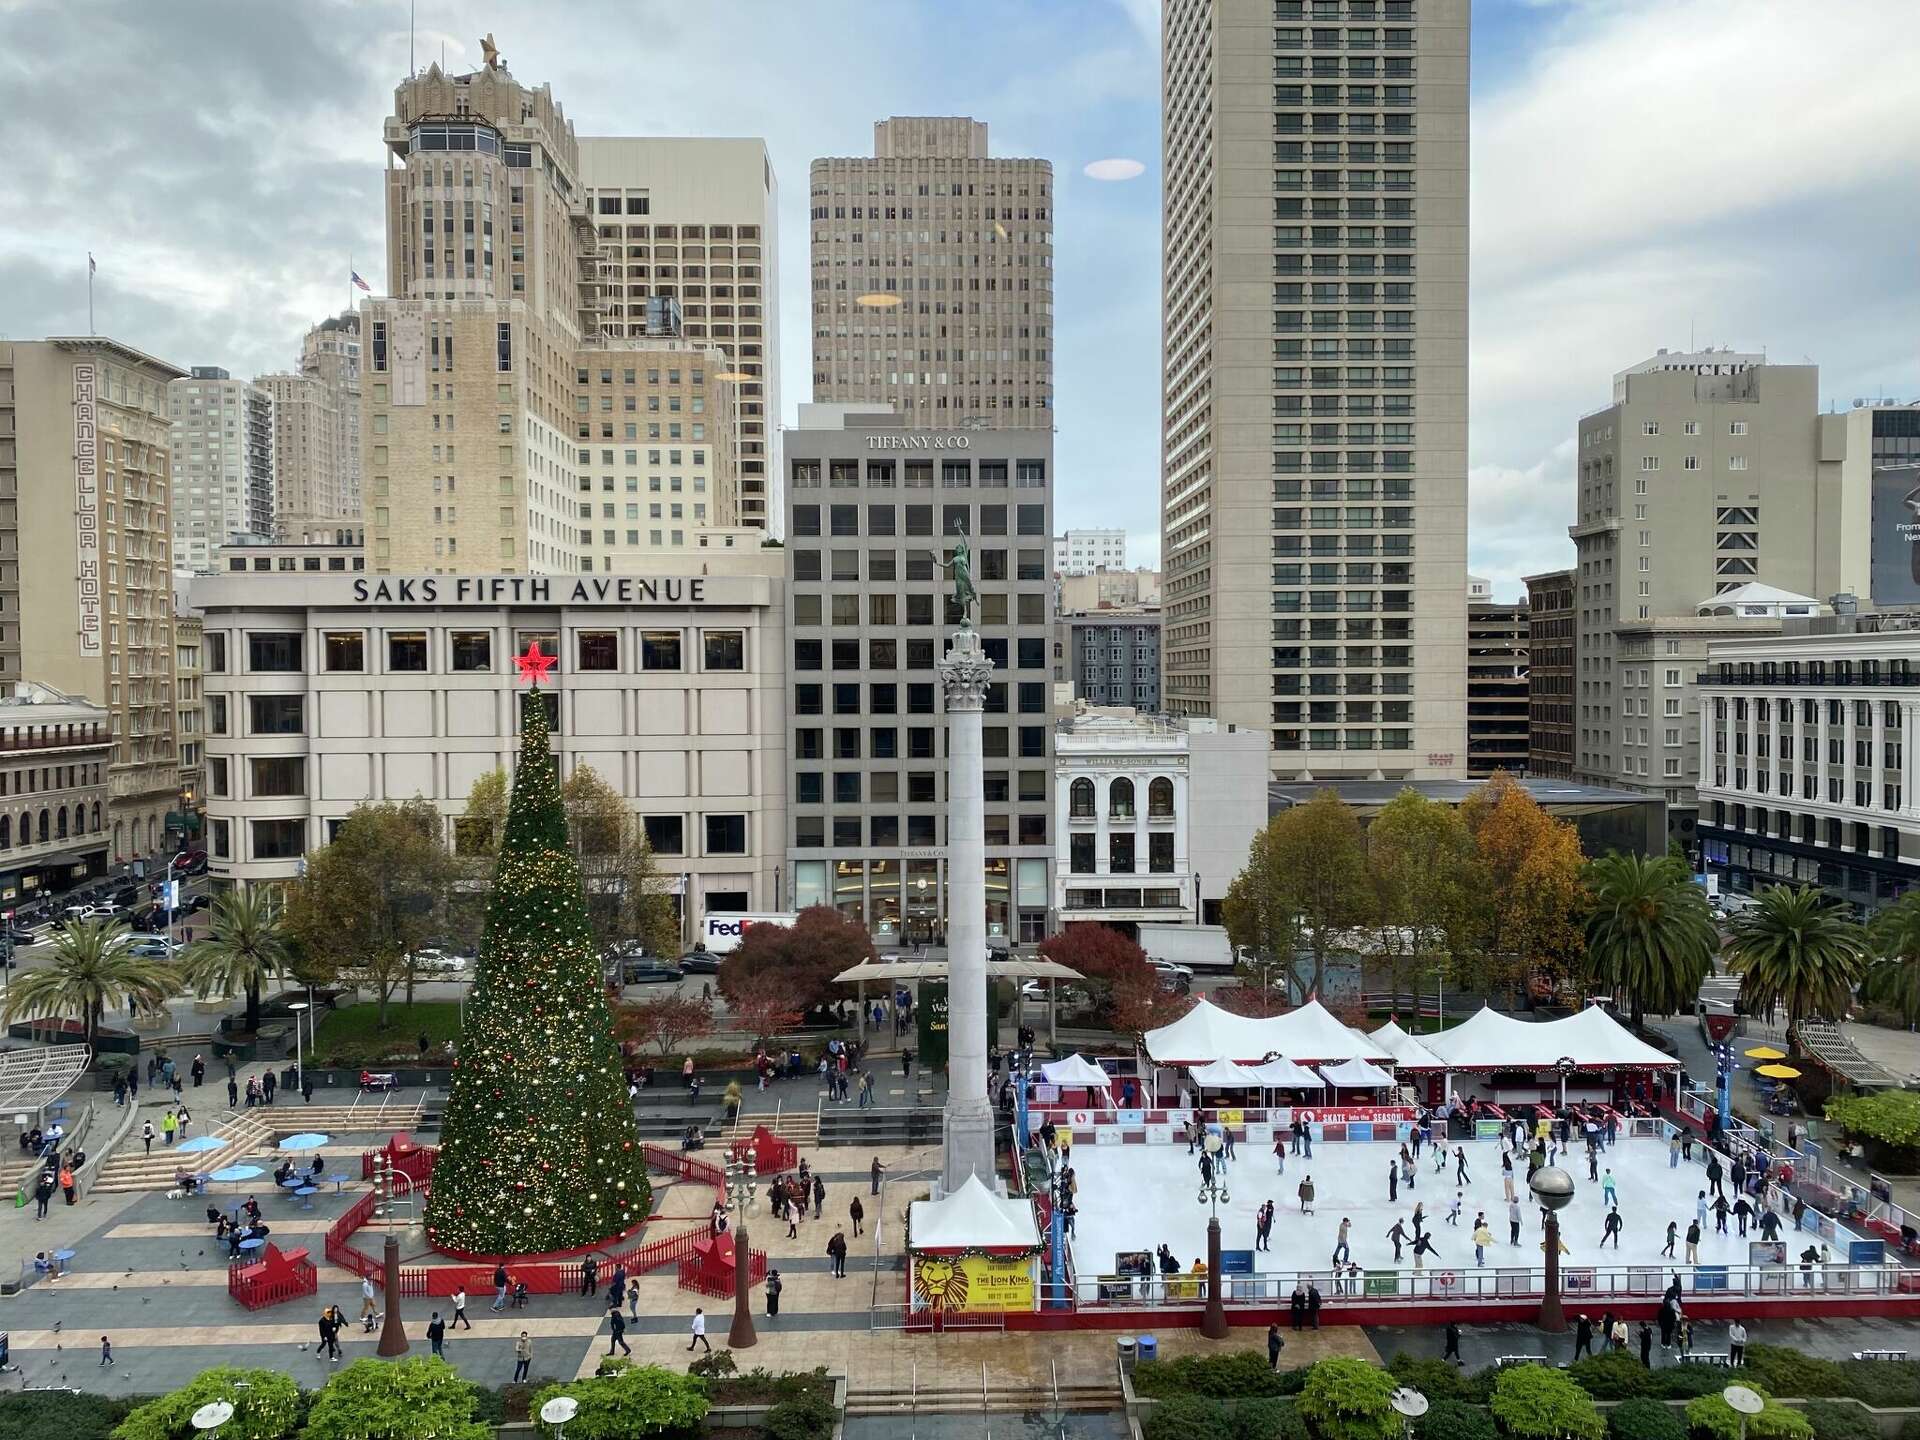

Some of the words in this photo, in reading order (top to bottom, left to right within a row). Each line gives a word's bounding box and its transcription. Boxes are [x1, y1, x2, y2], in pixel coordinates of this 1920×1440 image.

[866, 436, 931, 449] TIFFANY
[934, 436, 945, 449] &
[75, 366, 96, 549] CHANCELLOR
[354, 579, 437, 601] SAKS
[457, 579, 550, 601] FIFTH
[571, 579, 705, 601] AVENUE
[81, 560, 99, 649] HOTEL
[709, 920, 752, 936] Fed
[1323, 1113, 1346, 1122] SKATE
[1373, 1113, 1404, 1121] SEASON!
[991, 1275, 1008, 1286] LION
[1009, 1275, 1029, 1286] KING
